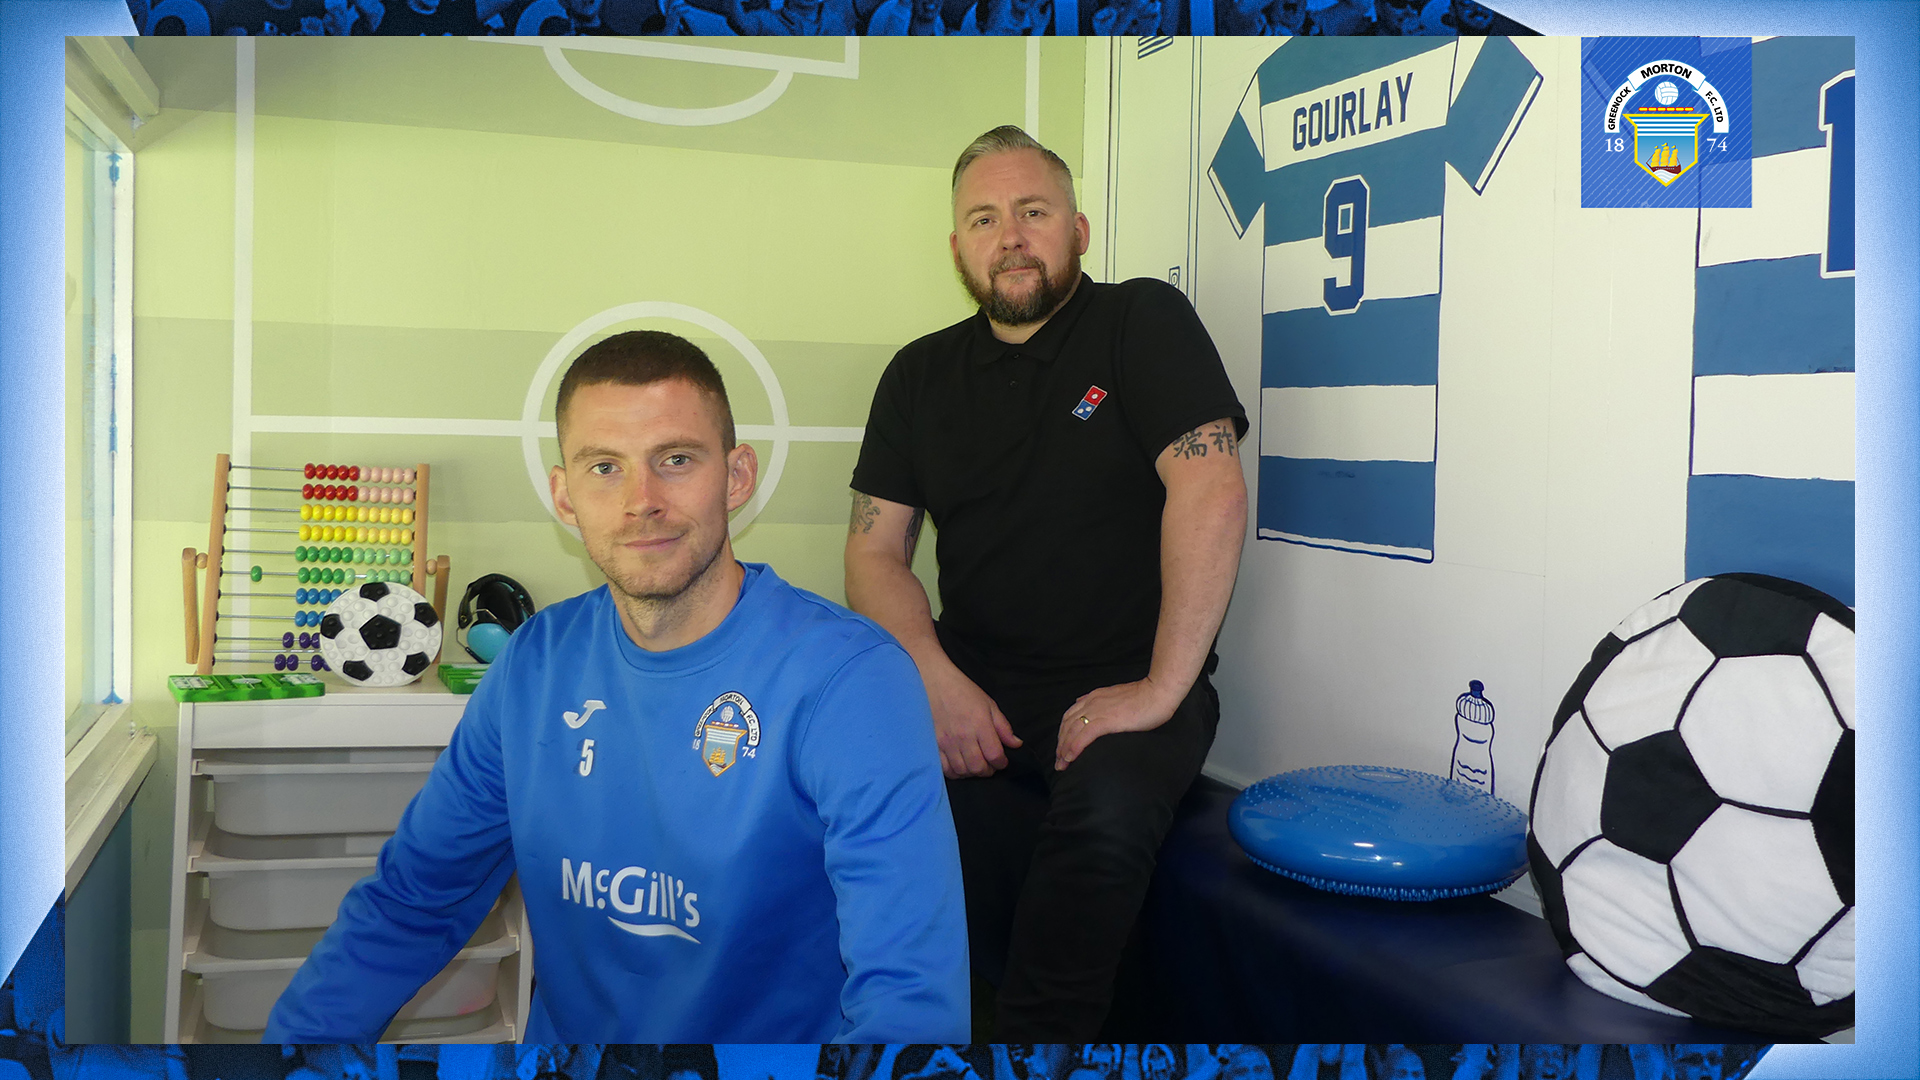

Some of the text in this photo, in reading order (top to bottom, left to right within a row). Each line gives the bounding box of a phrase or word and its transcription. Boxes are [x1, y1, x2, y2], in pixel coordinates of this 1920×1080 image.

[1293, 72, 1413, 151] GOURLAY
[1323, 175, 1369, 315] 9
[742, 746, 756, 758] 74
[750, 728, 758, 741] LTD
[579, 739, 594, 776] 5
